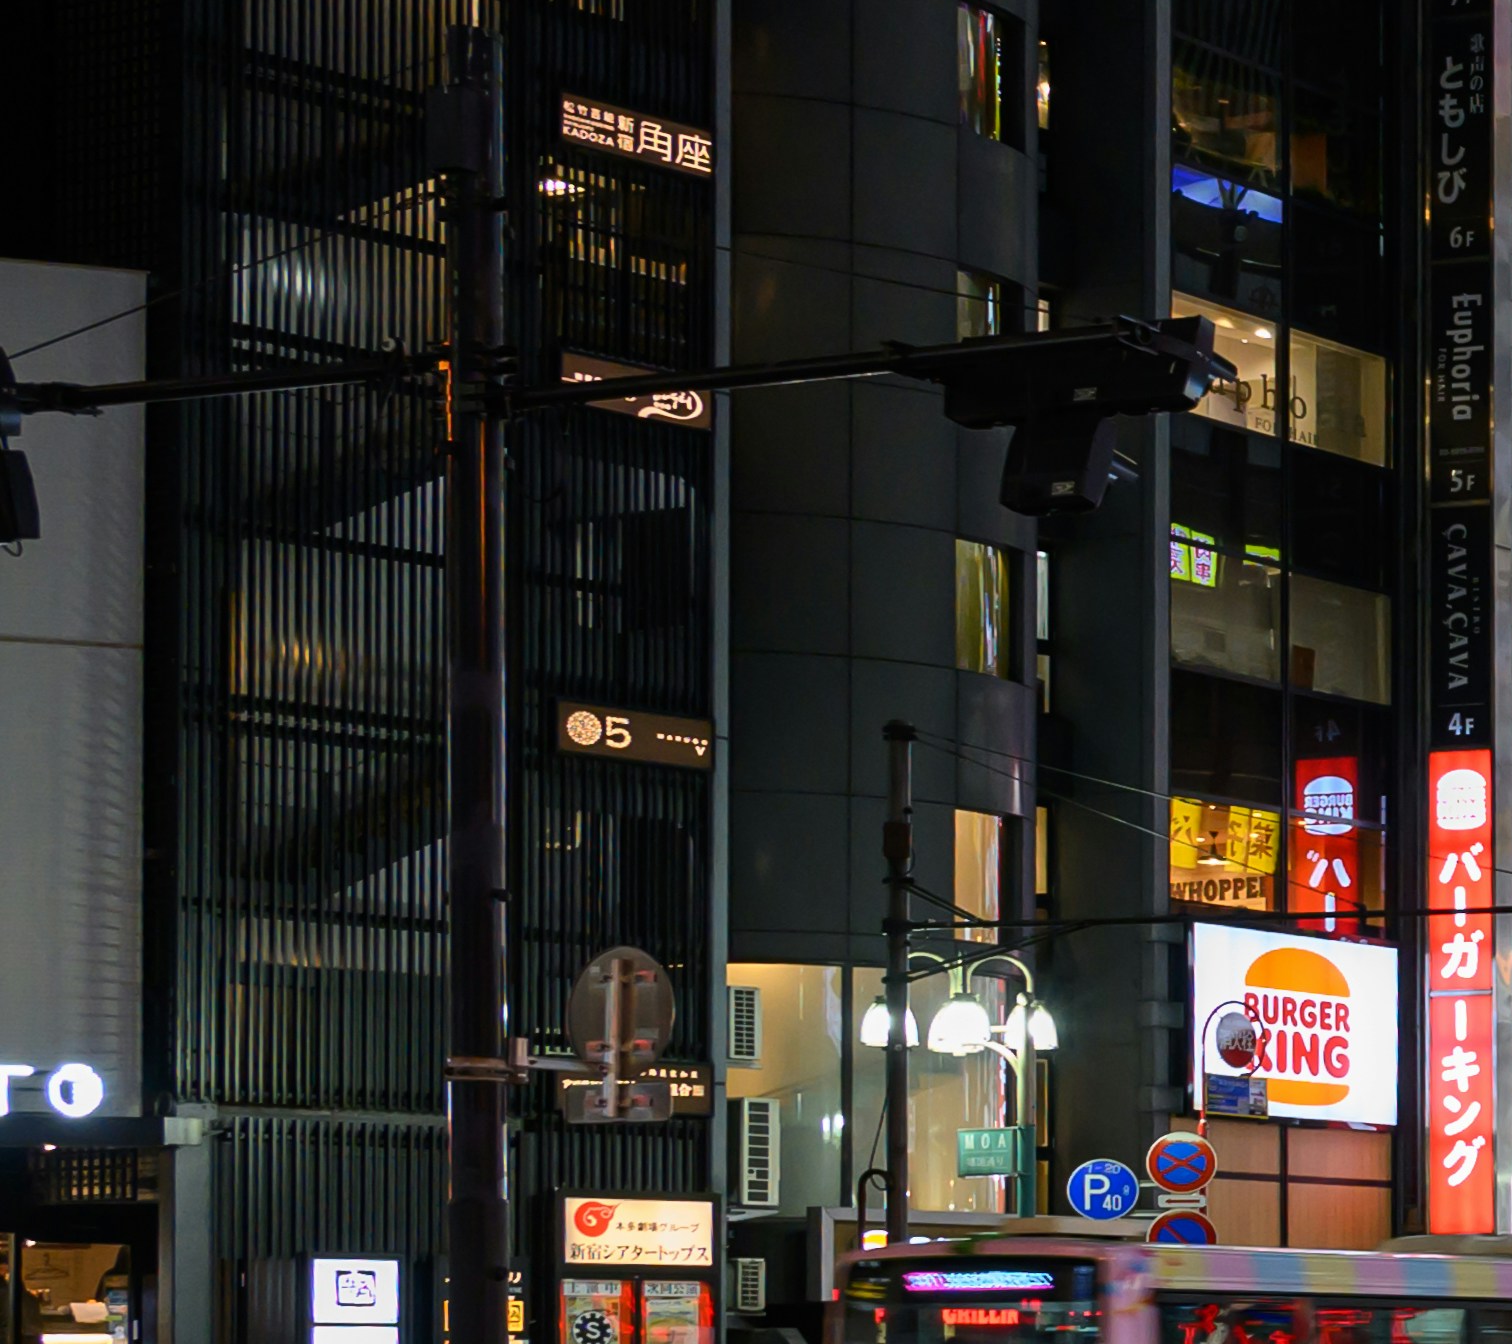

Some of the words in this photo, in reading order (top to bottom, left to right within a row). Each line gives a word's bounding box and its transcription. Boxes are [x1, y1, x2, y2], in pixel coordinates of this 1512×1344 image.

[636, 120, 713, 173] 角座
[1437, 56, 1466, 205] ともしび
[1449, 224, 1476, 250] 6F
[1451, 292, 1482, 423] Euphoria
[1449, 467, 1476, 493] 5F
[1448, 712, 1475, 736] 4F
[1244, 992, 1351, 1034] BURGER
[1437, 842, 1487, 1187] バーガーキング
[964, 1133, 1007, 1150] MOA
[1083, 1174, 1111, 1211] P
[1102, 1194, 1122, 1212] 40
[570, 1242, 710, 1262] 新宿シアタートップス
